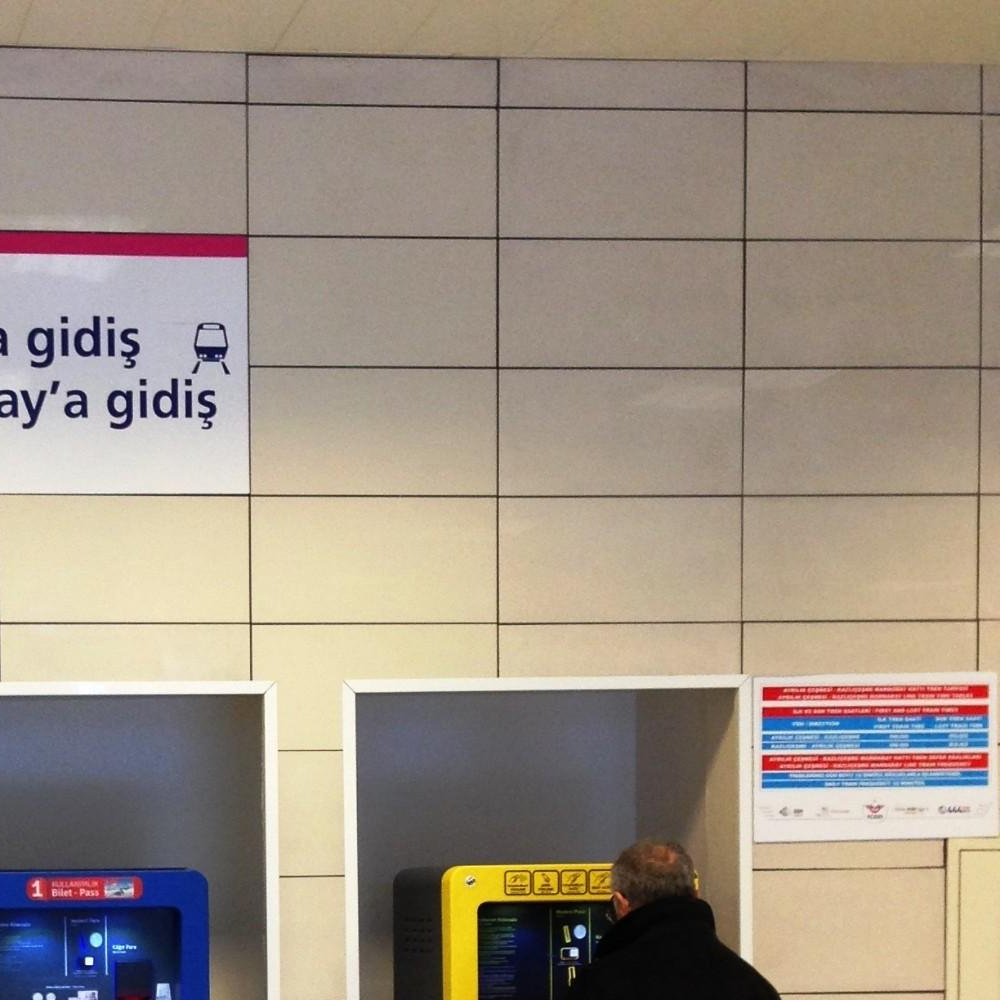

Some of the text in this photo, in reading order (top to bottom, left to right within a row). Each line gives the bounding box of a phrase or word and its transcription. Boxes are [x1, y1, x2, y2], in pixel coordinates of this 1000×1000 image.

[27, 316, 141, 368] gidiş
[106, 379, 218, 430] gidiş
[32, 880, 43, 897] 1
[52, 888, 100, 897] Bilet Pass
